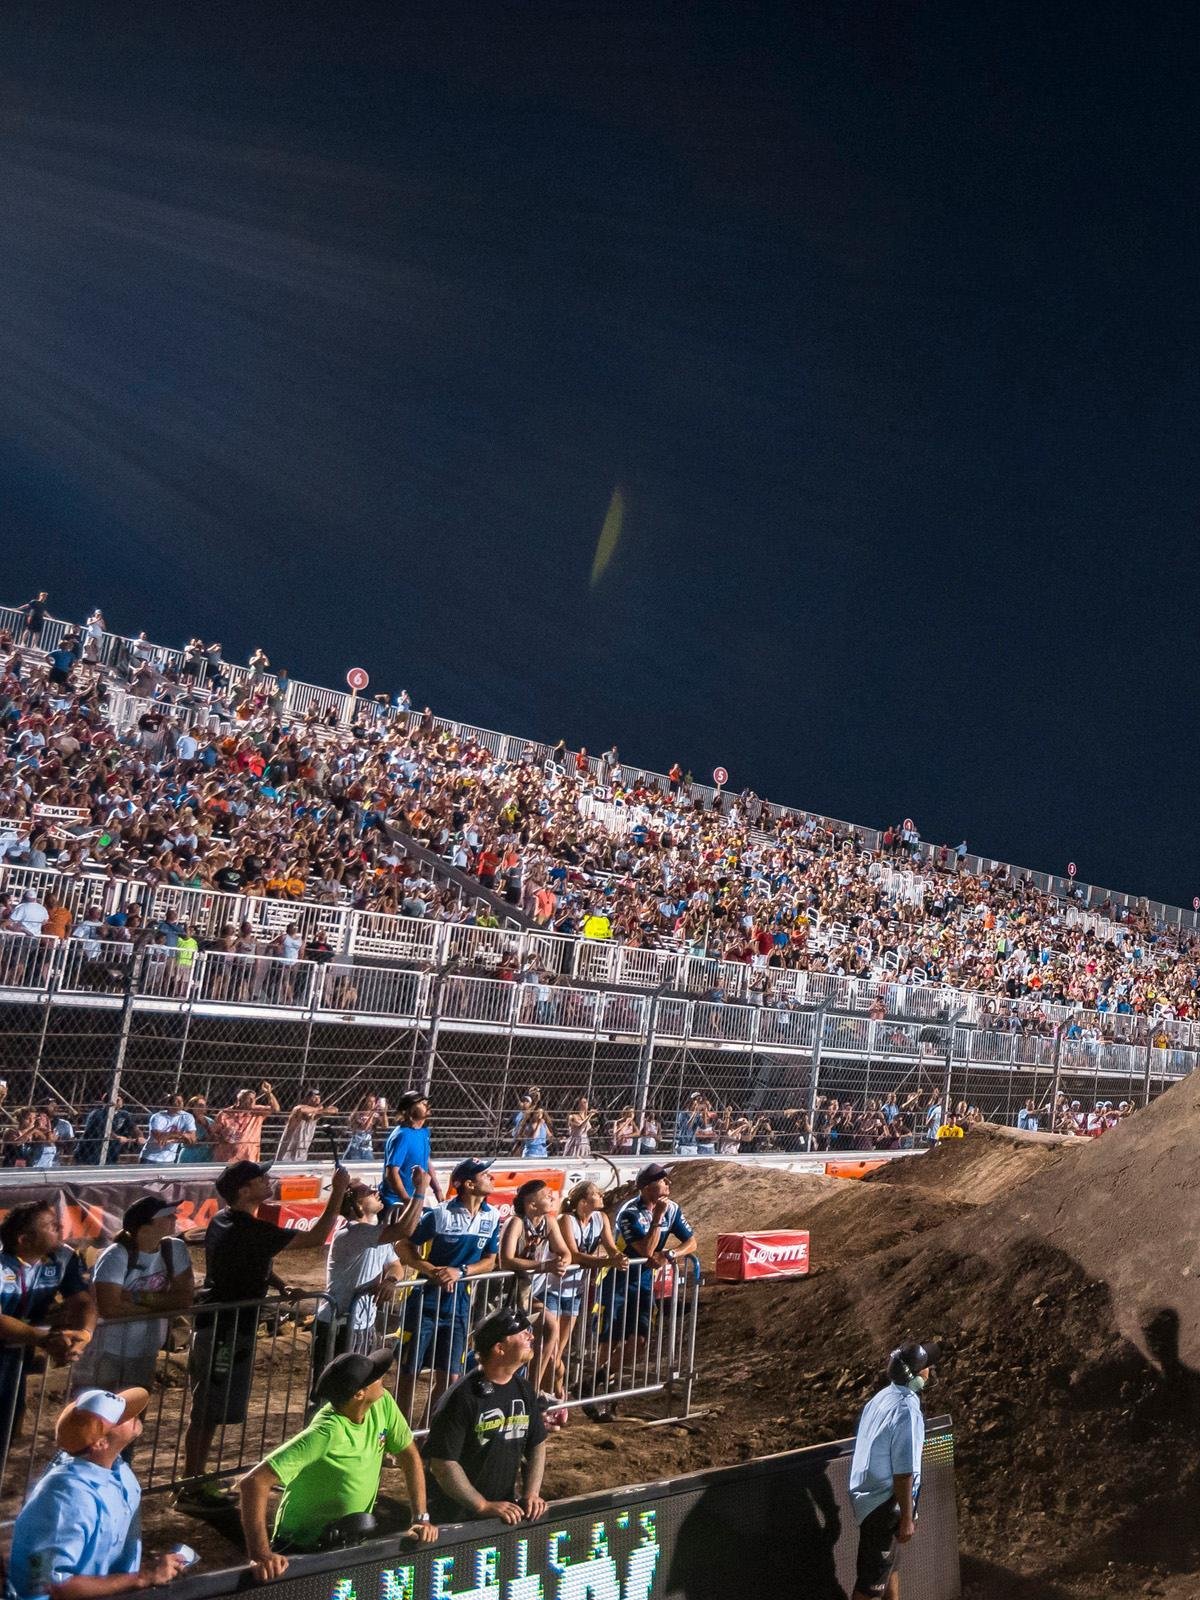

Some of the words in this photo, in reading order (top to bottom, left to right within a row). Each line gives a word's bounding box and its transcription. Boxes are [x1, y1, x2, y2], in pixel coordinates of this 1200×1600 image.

[354, 672, 363, 685] 6
[717, 770, 724, 780] 5
[747, 1244, 808, 1264] LOCTITE
